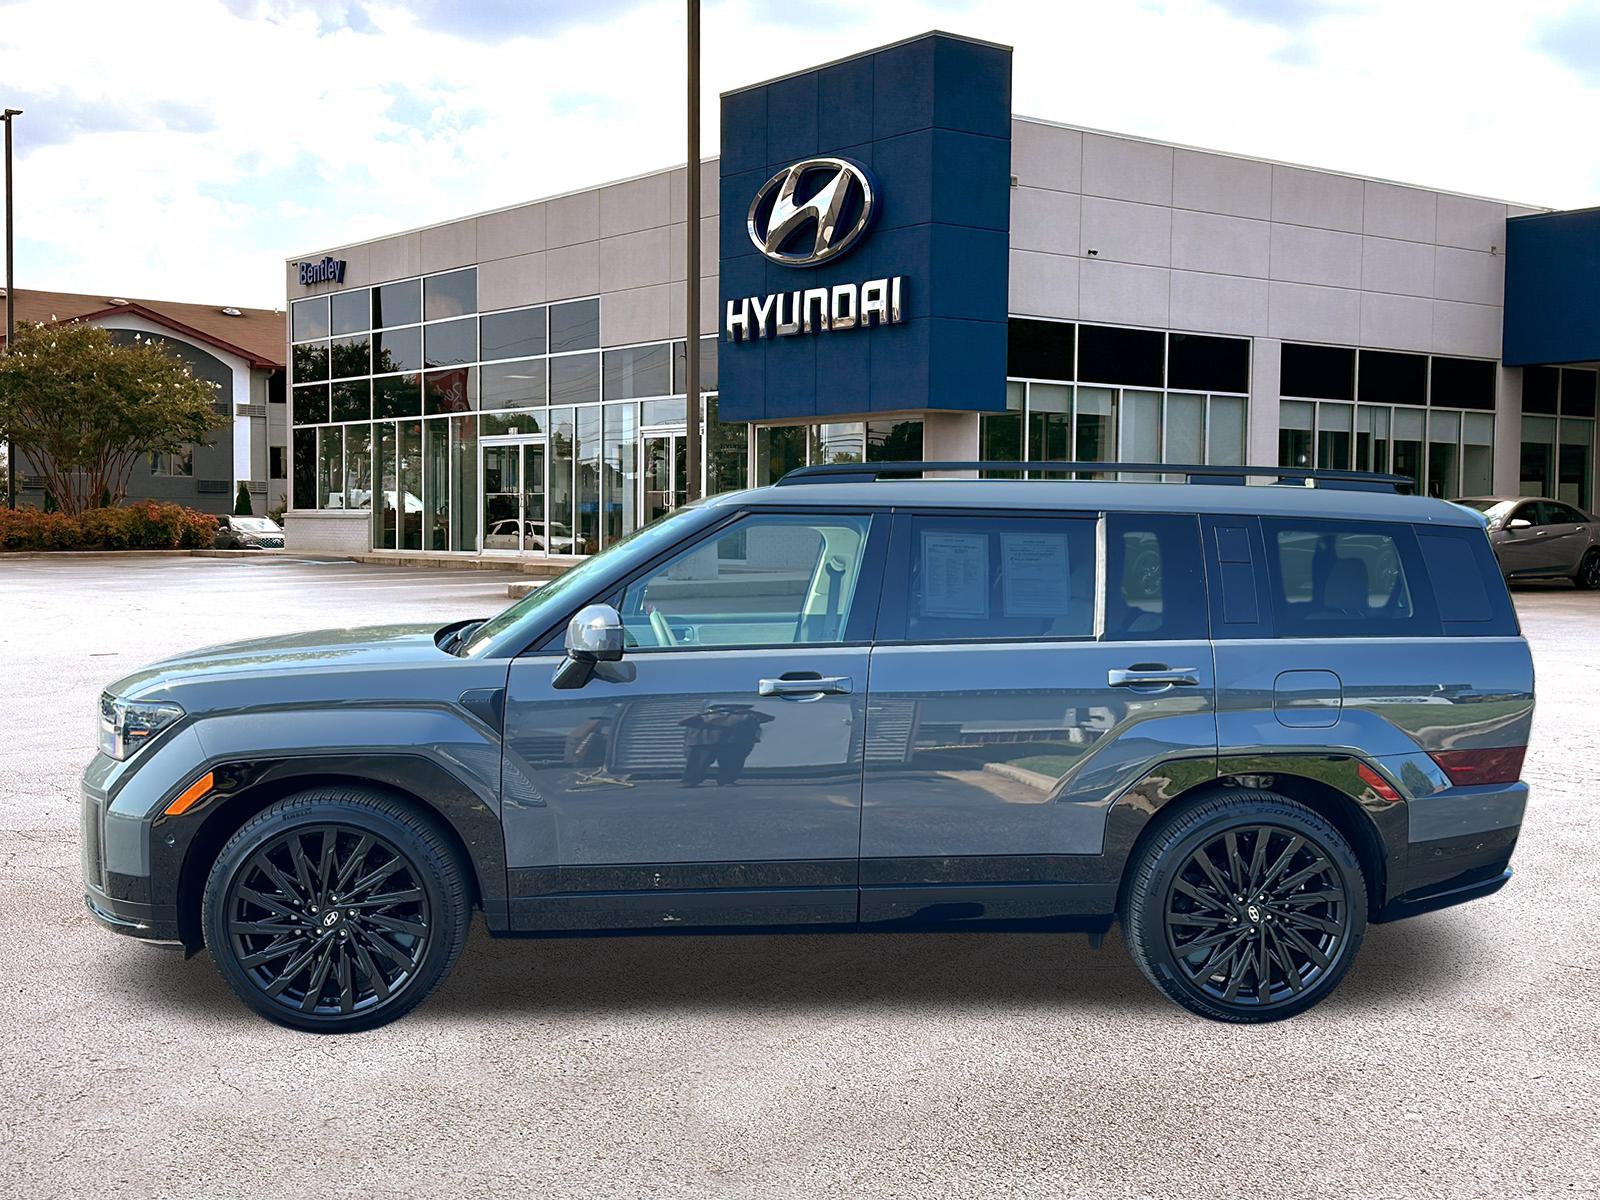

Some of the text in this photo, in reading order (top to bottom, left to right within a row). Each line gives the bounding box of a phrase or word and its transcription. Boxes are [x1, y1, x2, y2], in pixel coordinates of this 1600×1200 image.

[299, 257, 342, 284] Bentley
[726, 277, 901, 341] HYUNDAI
[1256, 807, 1323, 832] SCORPION
